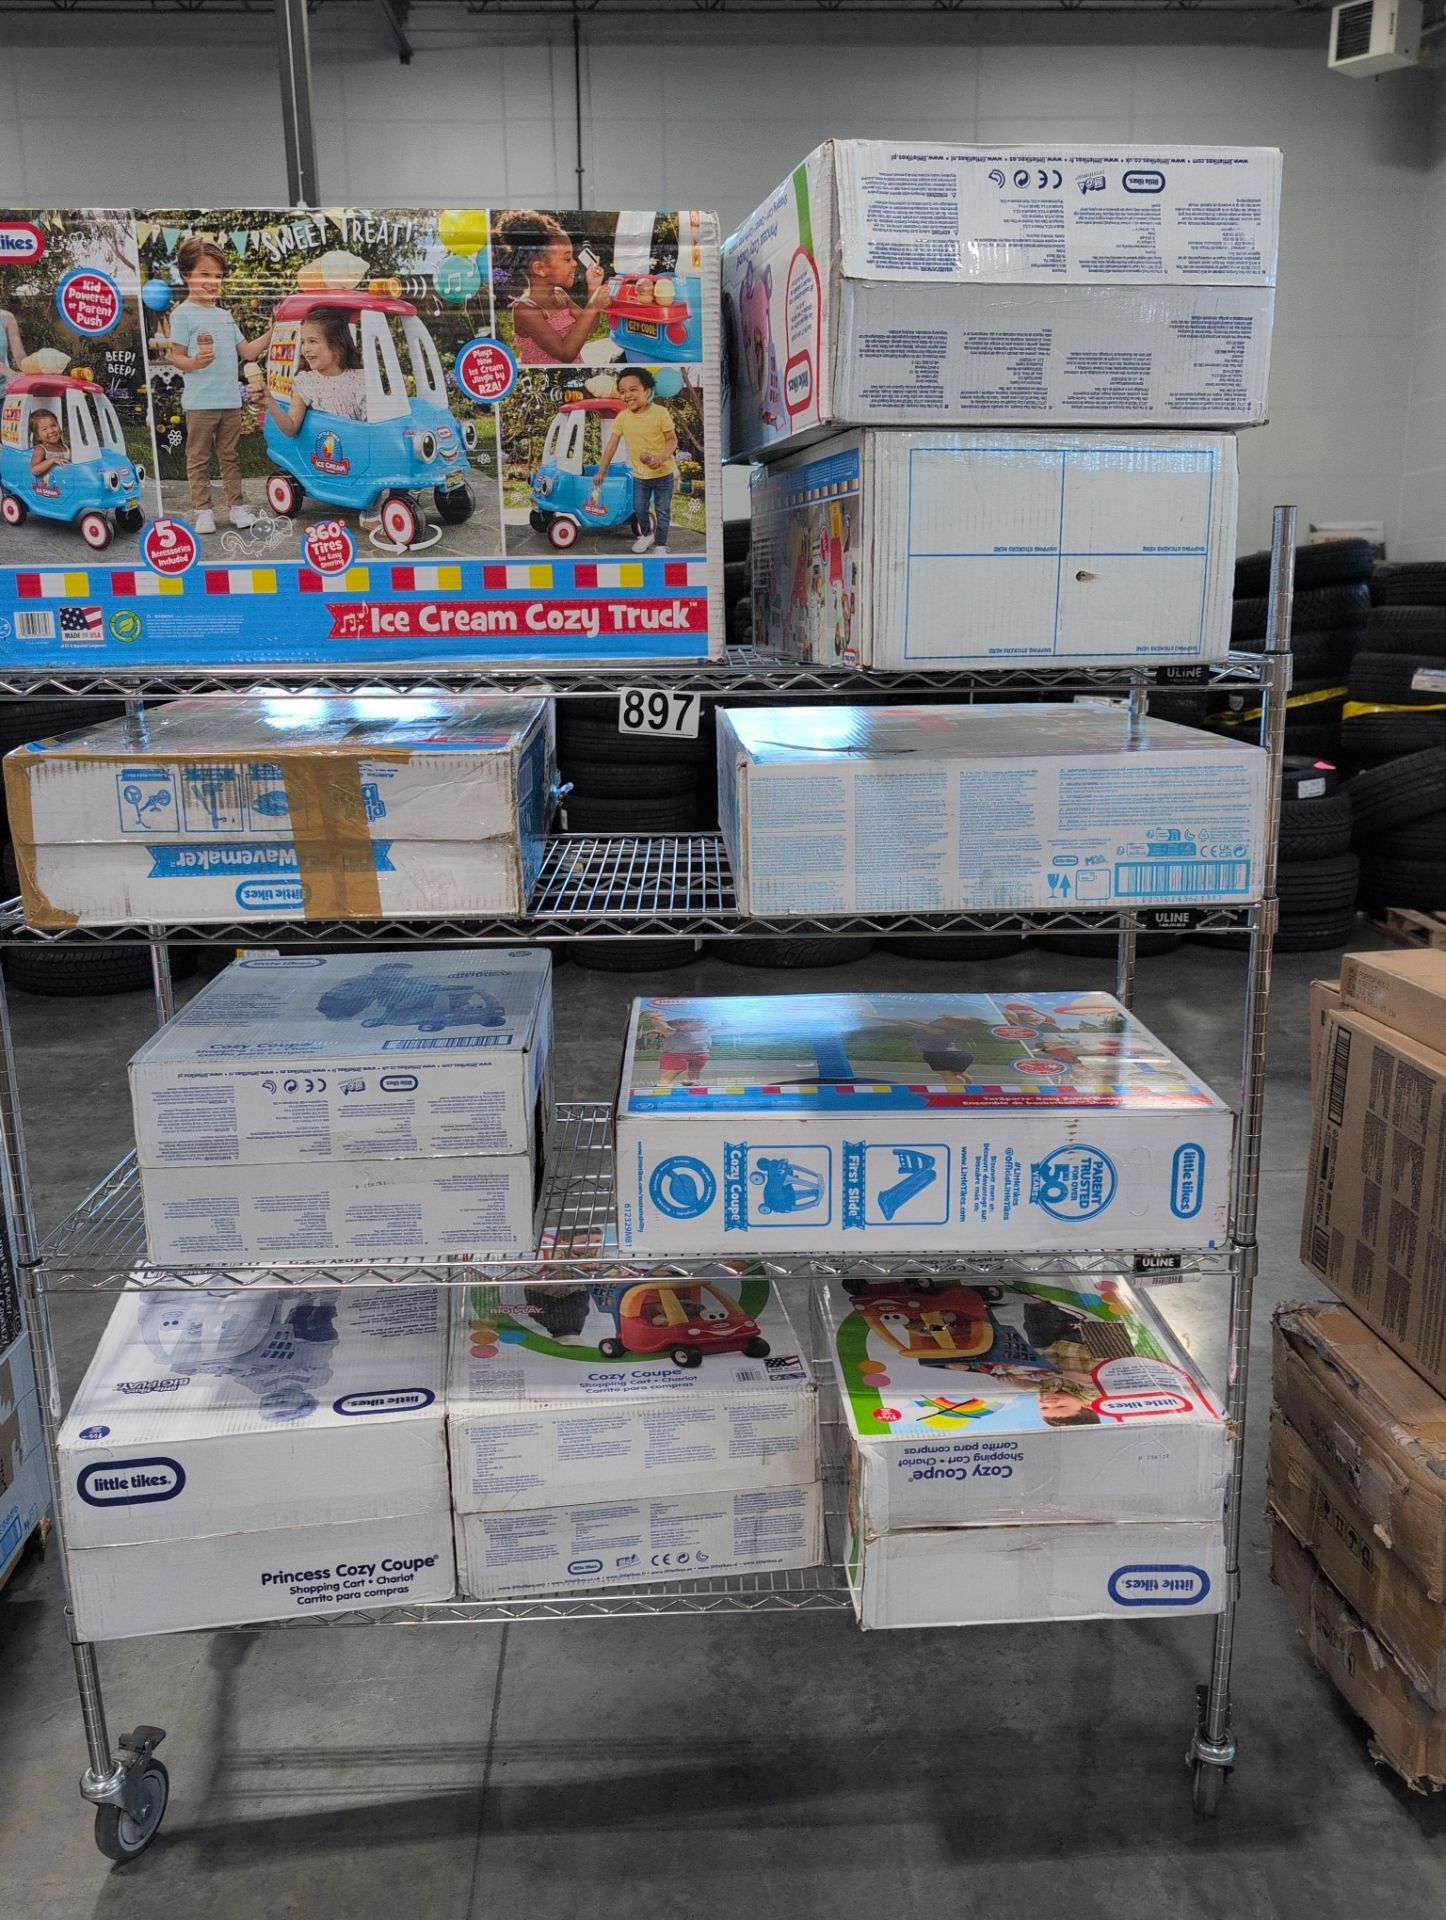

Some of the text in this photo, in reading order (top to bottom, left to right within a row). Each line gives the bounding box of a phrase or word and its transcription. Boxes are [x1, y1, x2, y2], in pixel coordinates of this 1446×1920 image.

[0, 235, 34, 250] ikes
[261, 223, 330, 262] SWEET
[82, 279, 102, 294] Kid
[68, 287, 112, 306] Powered
[68, 301, 112, 318] or Parent
[76, 312, 103, 327] Push
[105, 350, 136, 366] BEEP!
[108, 362, 136, 380] BEEP!
[480, 363, 504, 374] Cream
[472, 371, 506, 384] Jingle by
[478, 380, 503, 396] RZA!
[154, 520, 177, 548] 5
[306, 519, 346, 544] 360°
[151, 545, 192, 559] Accessories
[311, 539, 344, 553] Tires
[158, 555, 189, 568] Included
[371, 607, 410, 633] Ice
[418, 605, 517, 633] Cream
[525, 603, 600, 638] Cozy
[64, 632, 81, 640] MADE
[1167, 667, 1202, 678] ULINE
[622, 690, 692, 734] 897
[273, 889, 302, 902] little
[1155, 913, 1190, 923] ULINE
[725, 1150, 742, 1180] Cozy
[847, 1155, 860, 1184] First
[990, 1155, 998, 1184] Discover
[1181, 1151, 1196, 1180] little
[1012, 1161, 1022, 1206] #LittleTikes
[1039, 1163, 1070, 1204] 50
[1071, 1181, 1079, 1201] OVER
[1079, 1157, 1092, 1210] TRUSTED
[1091, 1160, 1104, 1206] PARENT
[1142, 1258, 1175, 1268] ULINE
[579, 1381, 628, 1389] Shopping
[661, 1375, 698, 1384] Chariot
[588, 1372, 626, 1382] Cozy
[586, 1382, 694, 1394] Carrito para compras
[387, 1394, 420, 1406] little
[1144, 1398, 1178, 1408] little
[904, 1441, 1018, 1456] Carrito para compras
[897, 1452, 1024, 1468] Shopping Cart Chariot
[972, 1463, 1014, 1479] Cozy
[94, 1477, 129, 1492] little
[261, 1567, 331, 1586] Princess
[336, 1562, 376, 1578] Cozy
[289, 1573, 415, 1596] Shopping Cart Chariot
[1161, 1577, 1194, 1592] little
[297, 1585, 410, 1606] Carrito para compras
